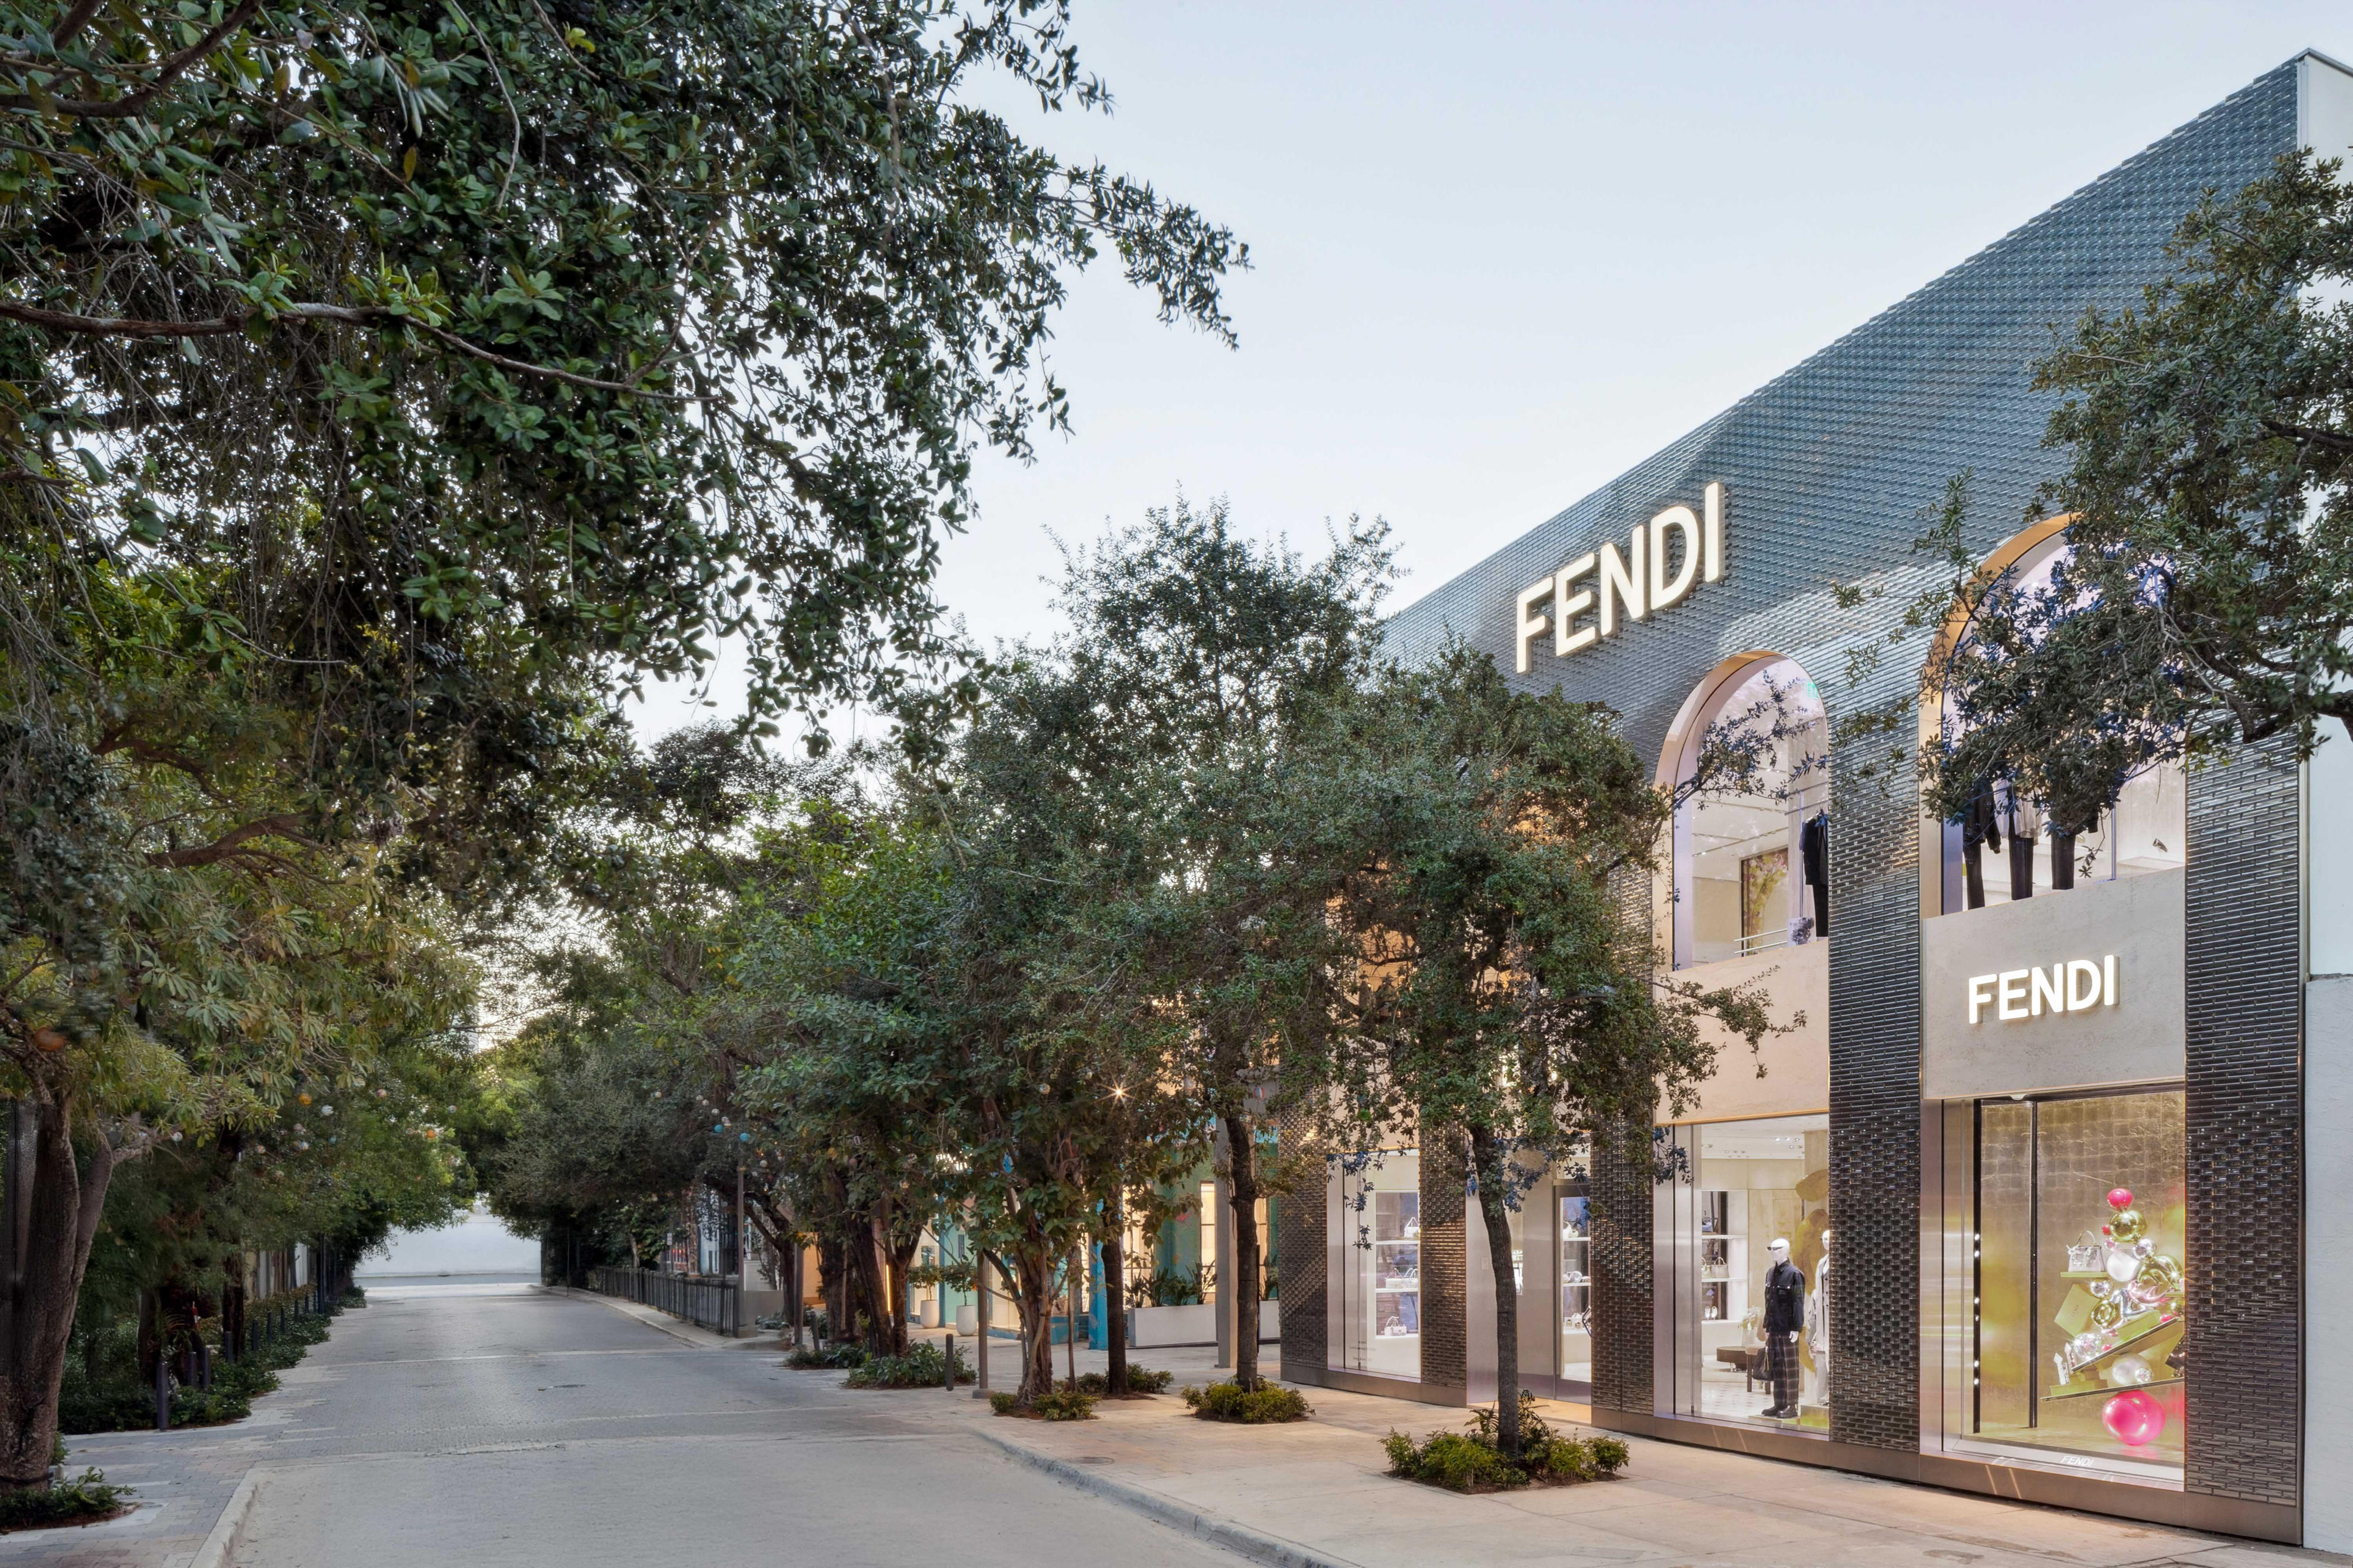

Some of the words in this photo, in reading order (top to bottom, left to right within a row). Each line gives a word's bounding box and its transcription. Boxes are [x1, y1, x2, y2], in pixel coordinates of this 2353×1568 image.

[1517, 482, 1725, 674] FENDI
[1968, 955, 2119, 1024] FENDI
[2061, 1455, 2094, 1467] FENDI
